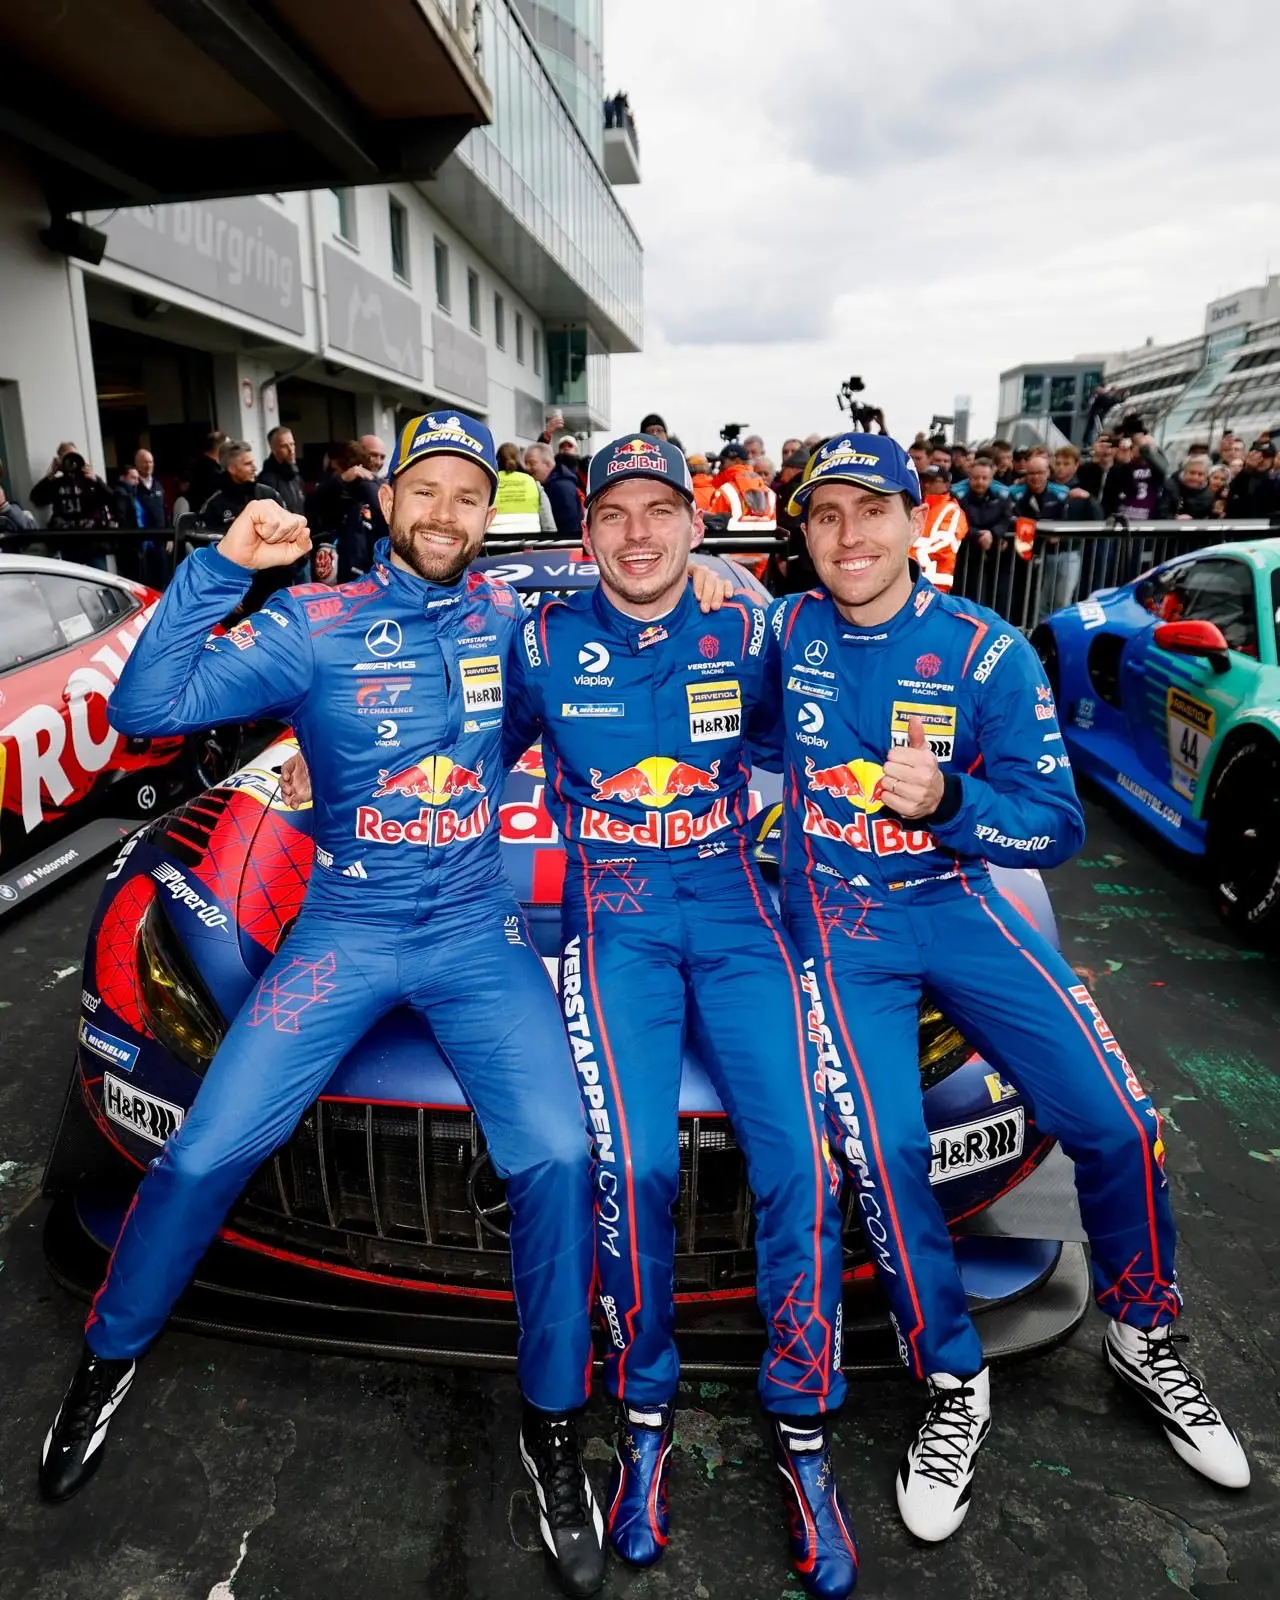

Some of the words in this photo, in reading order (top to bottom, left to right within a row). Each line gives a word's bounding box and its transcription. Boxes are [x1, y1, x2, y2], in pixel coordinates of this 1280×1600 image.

[412, 432, 484, 453] MICHELIN
[607, 455, 637, 476] Red
[638, 455, 667, 473] Bull
[809, 456, 879, 480] MICHELIN
[457, 635, 497, 645] VERSTAPPEN
[748, 608, 765, 656] sparco
[523, 620, 541, 668] sparco
[374, 661, 416, 671] AMG
[687, 661, 735, 670] VERSTAPPEN
[973, 634, 1014, 684] sparco
[466, 667, 498, 676] RAVENOL
[573, 675, 614, 688] viaplay
[804, 666, 836, 680] AMG
[466, 688, 490, 704] H&R
[801, 685, 834, 697] MICHELIN
[897, 679, 955, 692] VERSTAPPEN
[912, 688, 939, 696] RACING
[694, 692, 735, 701] RAVENOL
[369, 706, 414, 715] CHALLENGE
[692, 717, 723, 735] H&R
[374, 740, 401, 748] viaplay
[795, 732, 829, 750] viaplay
[1180, 727, 1198, 770] 44
[355, 805, 433, 847] Red
[434, 796, 491, 847] Bull
[580, 806, 661, 849] Red
[664, 796, 731, 849] Bull
[803, 795, 872, 853] Red
[872, 818, 937, 857] Bu
[37, 850, 78, 886] Motorsport
[316, 850, 335, 869] OMP
[504, 915, 527, 946] JULES
[88, 1034, 131, 1062] MICHELIN
[107, 1081, 147, 1128] H&R
[928, 1131, 983, 1176] H&R
[600, 1295, 625, 1349] sparco
[833, 1303, 843, 1371] sparco
